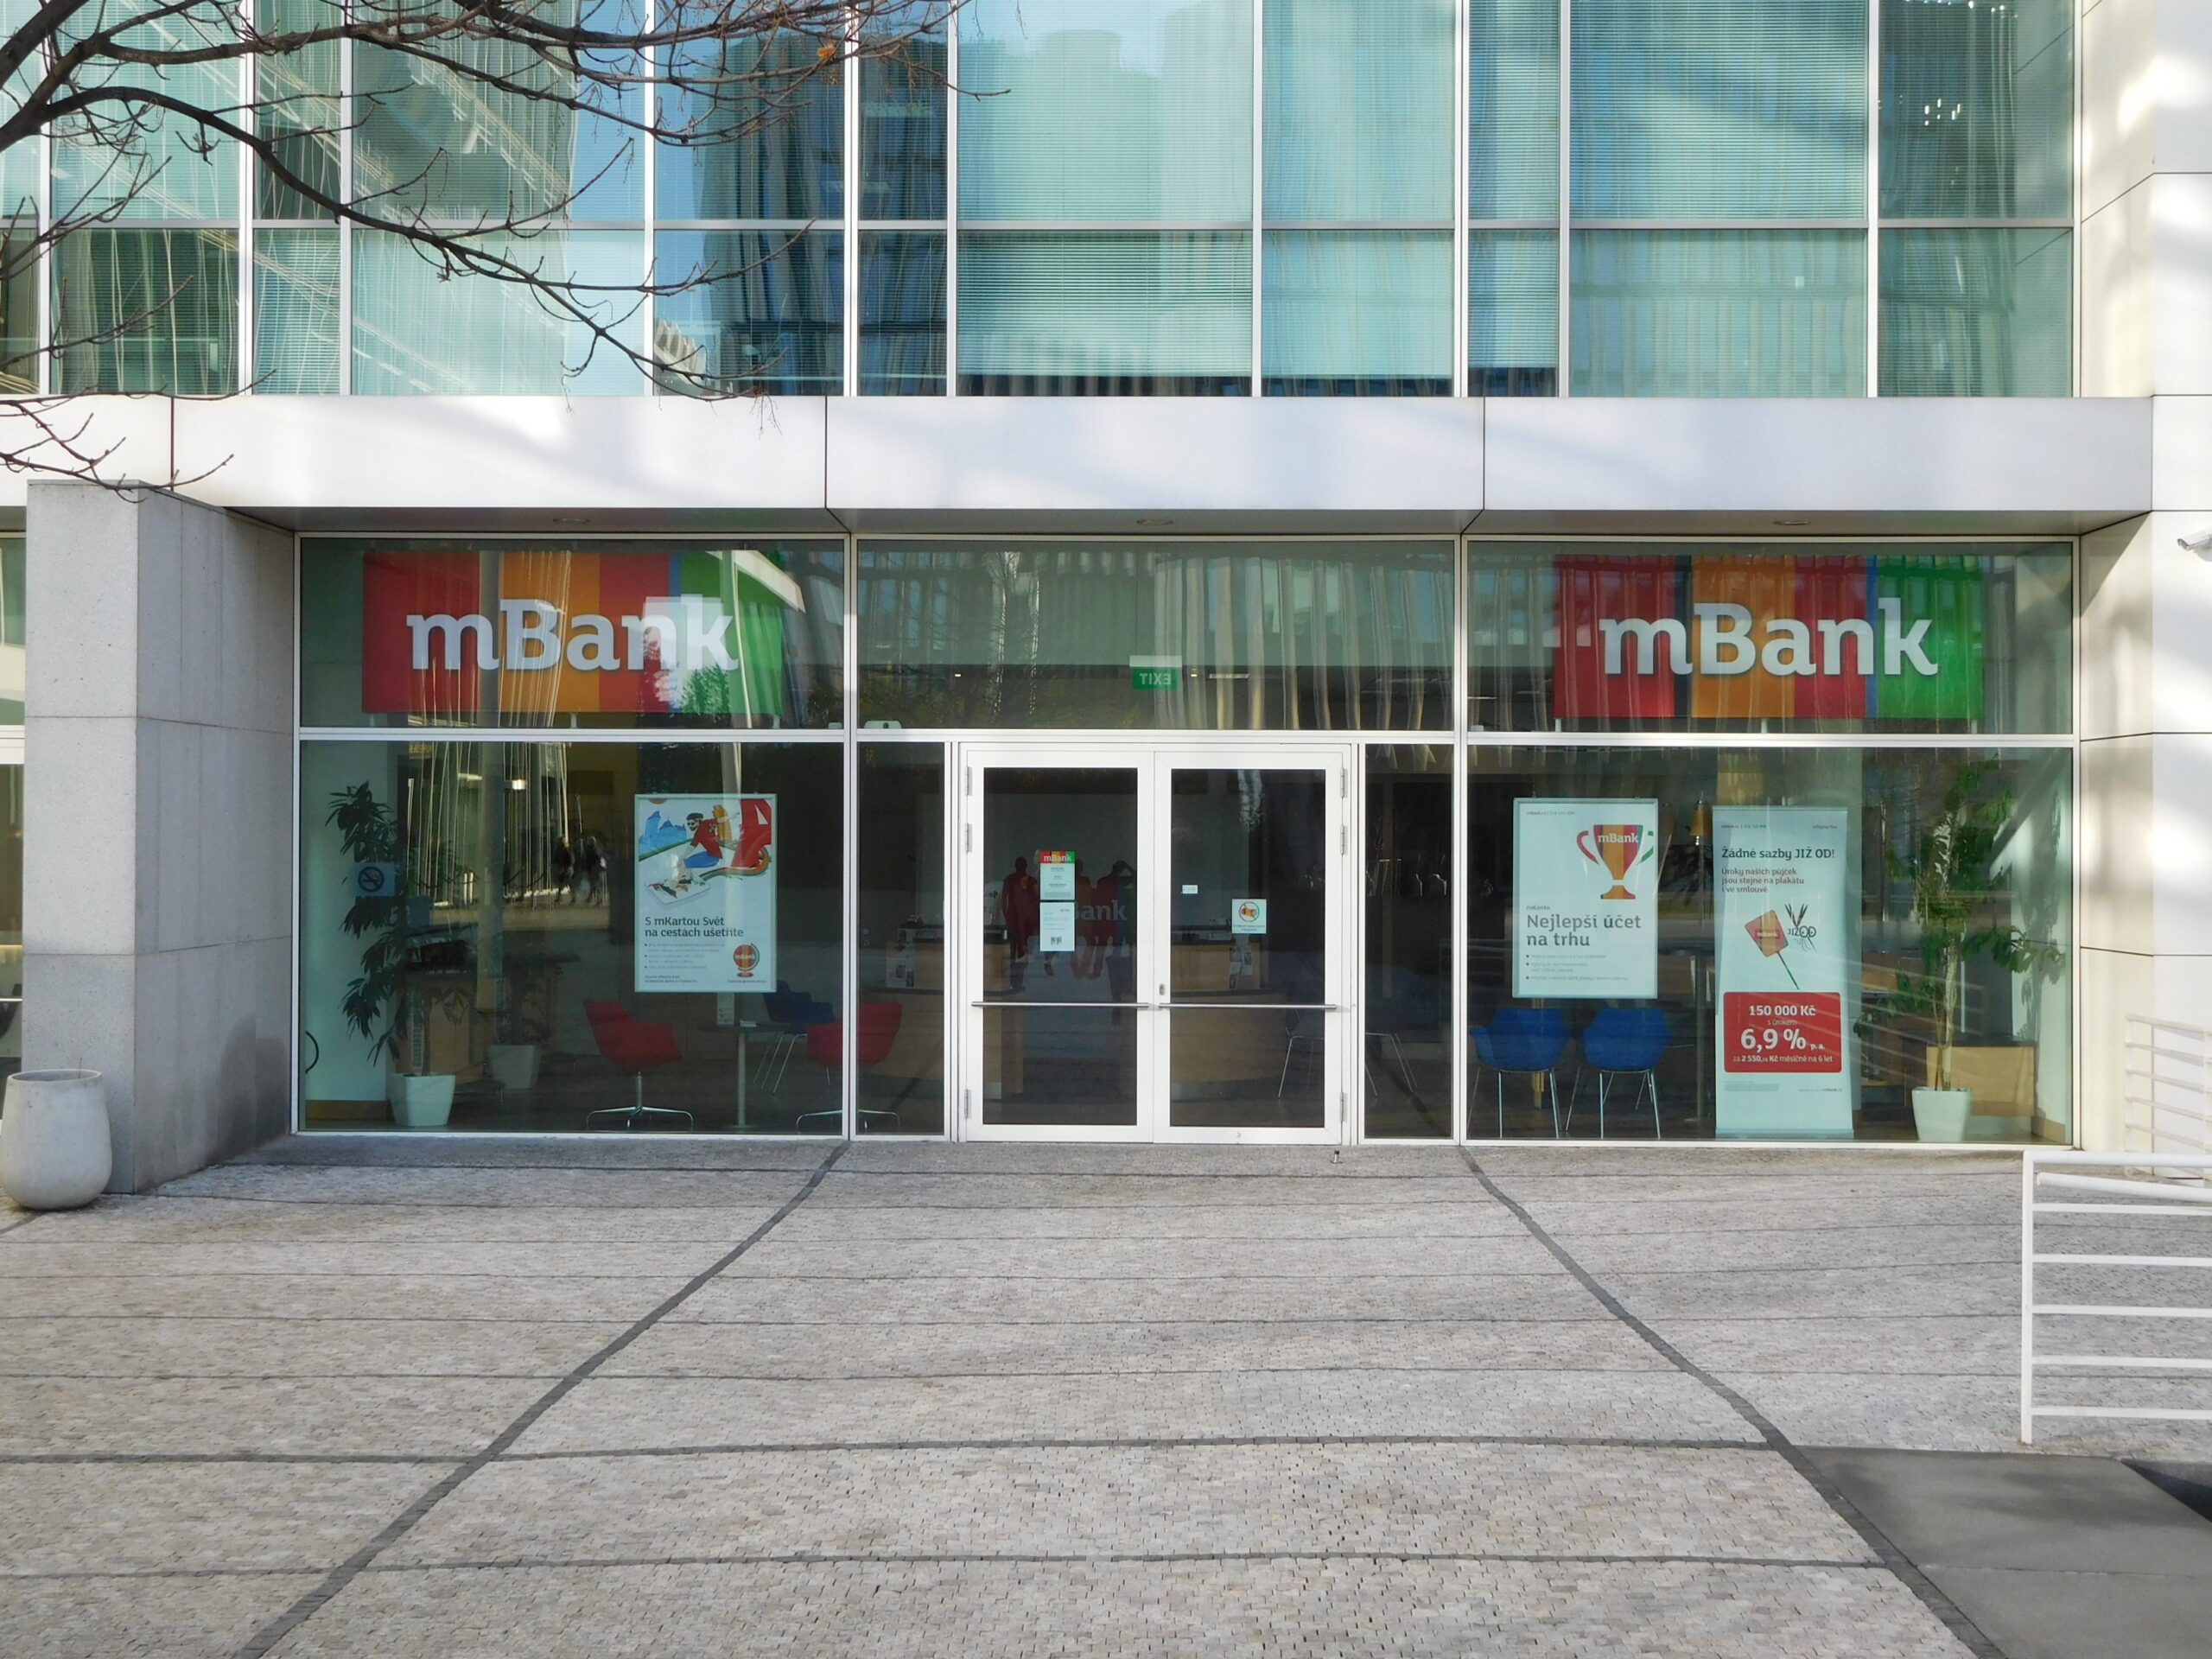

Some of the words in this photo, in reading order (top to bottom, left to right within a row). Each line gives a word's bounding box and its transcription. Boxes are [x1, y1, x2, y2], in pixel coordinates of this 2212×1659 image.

[406, 594, 740, 671] mBank
[1599, 597, 1938, 676] mBank
[1599, 832, 1638, 843] mBank
[1721, 846, 1756, 858] Žádné
[1759, 849, 1792, 861] sazby
[1795, 847, 1812, 858] JIŽ
[1815, 849, 1834, 858] OD!
[645, 917, 651, 925] S
[654, 917, 699, 926] mKartou
[703, 916, 725, 926] Svět
[1527, 914, 1598, 931] Nejlepší
[1604, 914, 1641, 928] účet
[661, 927, 701, 937] cestách
[1527, 935, 1548, 946] na
[1554, 931, 1590, 946] trhu
[1749, 1006, 1771, 1015] 150
[1774, 1006, 1797, 1015] 000
[1801, 1005, 1816, 1015] Kč
[1741, 1028, 1778, 1053] 6,9
[1783, 1028, 1807, 1049] %
